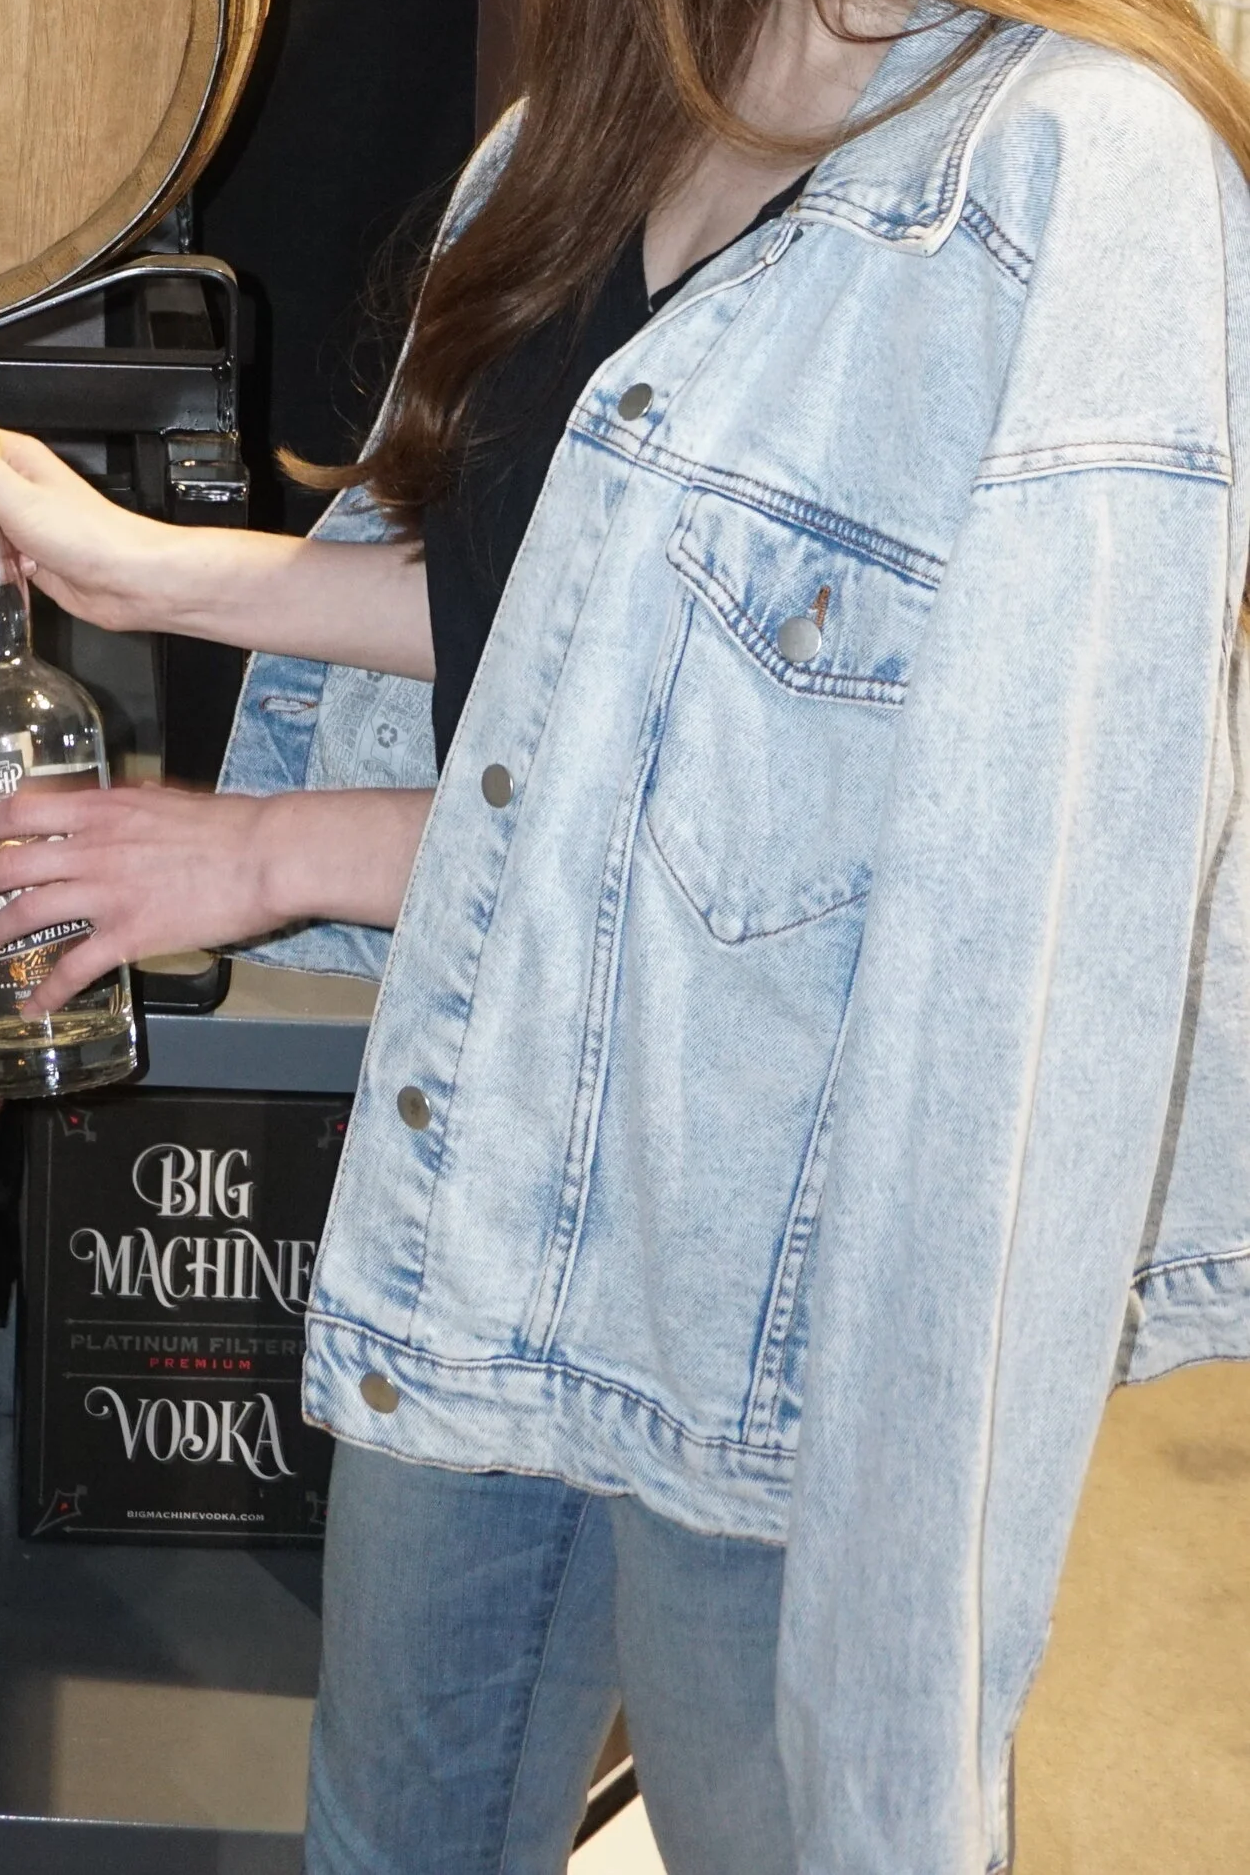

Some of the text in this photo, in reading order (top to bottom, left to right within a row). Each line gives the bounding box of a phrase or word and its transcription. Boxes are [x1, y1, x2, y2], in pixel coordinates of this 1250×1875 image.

[31, 919, 90, 944] WHISKE
[132, 1143, 254, 1219] BIG
[70, 1227, 316, 1316] MACHINE
[70, 1334, 306, 1355] PLATINUM FILTER
[150, 1357, 252, 1370] PREMIUM
[85, 1386, 297, 1481] VODKA
[127, 1509, 266, 1522] BIGMACHINEVODKA.COM
